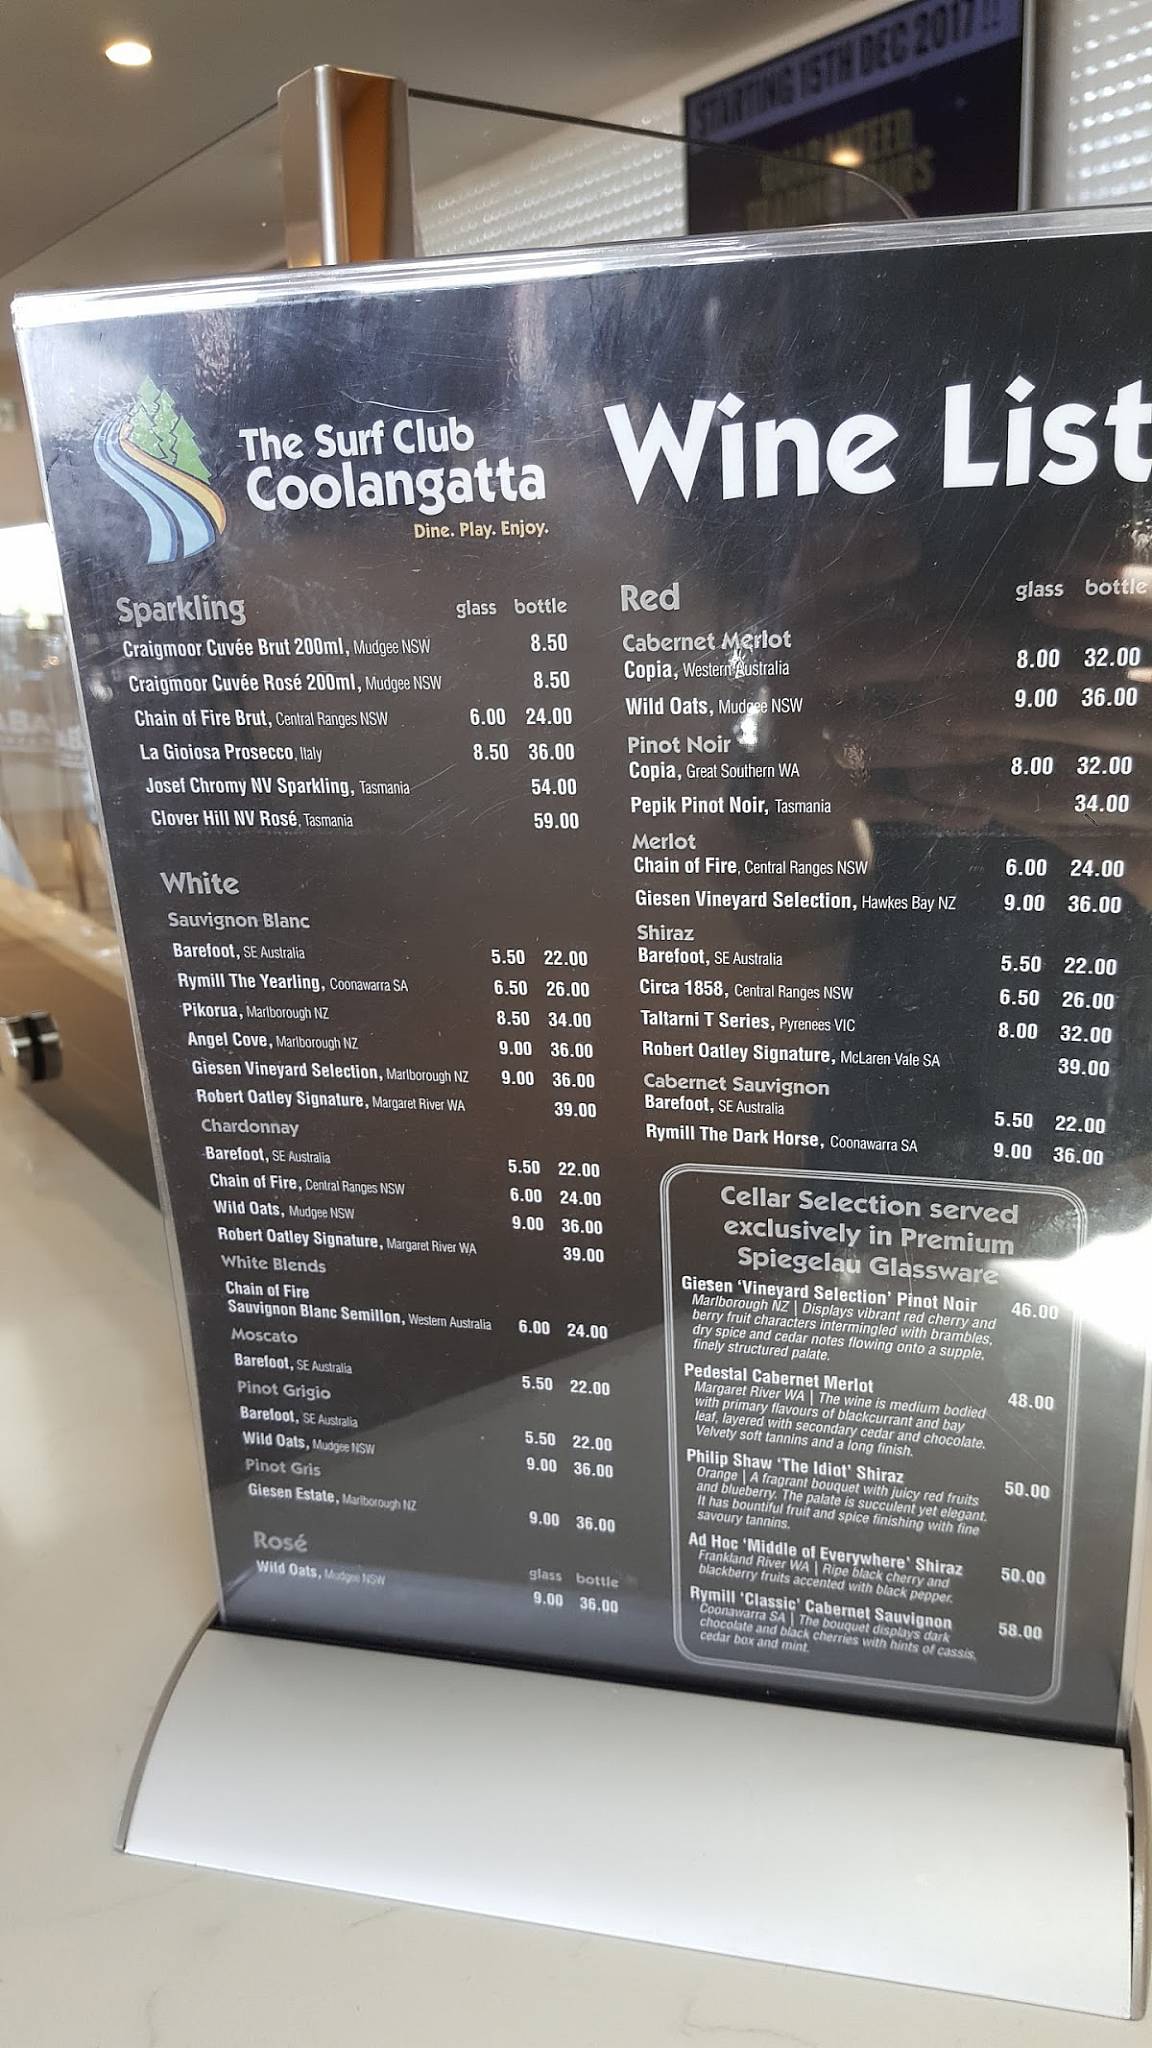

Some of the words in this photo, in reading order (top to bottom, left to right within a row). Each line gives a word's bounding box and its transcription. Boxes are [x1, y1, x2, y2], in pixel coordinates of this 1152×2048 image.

[859, 27, 909, 73] DEC
[913, 0, 974, 57] 2017
[238, 427, 303, 461] The
[315, 419, 384, 458] Surf
[393, 417, 474, 453] Club
[603, 392, 899, 504] Wine
[943, 375, 1152, 487] List
[246, 457, 546, 516] Coolangatta
[413, 523, 454, 539] Dine.
[459, 521, 496, 539] Play.
[500, 520, 549, 537] Enjoy.
[621, 582, 681, 612] Red
[1015, 581, 1064, 601] glass
[1085, 579, 1147, 596] bottle
[116, 595, 246, 628] Sparkling
[455, 600, 497, 618] glass
[513, 598, 568, 615] bottle
[123, 639, 202, 662] Craigmoor
[206, 638, 254, 657] Cuvée
[258, 639, 291, 656] Brut
[294, 637, 350, 657] 200ml,
[353, 639, 399, 657] Mudgee
[402, 638, 431, 654] NSW
[530, 634, 568, 652] 8.50
[622, 632, 716, 652] Cabernet
[721, 630, 791, 651] Merlot
[1016, 648, 1061, 669] 8.00
[1084, 647, 1141, 667] 32.00
[624, 659, 679, 682] Copia,
[682, 661, 732, 678] Western
[735, 660, 790, 677] Australia
[134, 709, 178, 727] Chain
[181, 709, 196, 727] of
[200, 709, 231, 726] Fire
[234, 709, 273, 729] Brut,
[275, 712, 314, 726] Central
[317, 712, 357, 729] Ranges
[359, 711, 388, 726] NSW
[469, 708, 506, 726] 6.00
[525, 707, 573, 725] 24.00
[140, 743, 159, 760] La
[162, 743, 220, 761] Gioiosa
[224, 743, 298, 762] Prosecco,
[300, 746, 323, 764] Italy
[473, 743, 509, 761] 8.50
[528, 743, 575, 761] 36.00
[145, 777, 186, 796] Josef
[189, 776, 246, 798] Chromy
[251, 777, 272, 794] NV
[277, 778, 355, 799] Sparkling,
[359, 780, 410, 795] Tasmania
[530, 777, 577, 796] 54.00
[630, 795, 676, 817] Pepik
[681, 795, 725, 814] Pinot
[729, 795, 769, 816] Noir,
[775, 799, 832, 814] Tasmania
[1073, 793, 1130, 813] 34.00
[631, 834, 696, 850] Merlot
[160, 872, 240, 895] White
[635, 890, 690, 908] Giesen
[695, 891, 767, 911] Vineyard
[772, 892, 857, 912] Selection,
[861, 894, 907, 911] Hawkes
[911, 896, 935, 912] Bay
[938, 895, 956, 911] NZ
[1003, 894, 1045, 912] 9.00
[1067, 895, 1122, 914] 36.00
[167, 912, 259, 930] Sauvignon
[263, 913, 310, 929] Blanc
[636, 925, 695, 942] Shiraz
[173, 943, 240, 961] Barefoot,
[243, 945, 258, 959] SE
[261, 945, 305, 960] Australia
[491, 949, 525, 965] 5.50
[543, 950, 588, 967] 22.00
[178, 973, 226, 992] Rymill
[229, 973, 256, 989] The
[259, 974, 326, 994] Yearling,
[330, 978, 391, 992] Coonawarra
[393, 979, 409, 992] SA
[494, 980, 528, 996] 6.50
[546, 981, 590, 998] 26.00
[639, 978, 680, 996] Circa
[684, 979, 729, 999] 1858,
[734, 983, 775, 998] Central
[778, 984, 820, 1001] Ranges
[823, 985, 853, 1000] NSW
[999, 989, 1040, 1007] 6.50
[1061, 991, 1115, 1010] 26.00
[640, 1009, 699, 1028] Taltarni
[703, 1011, 715, 1028] T
[718, 1012, 775, 1031] Series,
[779, 1016, 832, 1033] Pyrenees
[834, 1017, 855, 1032] VIC
[998, 1022, 1038, 1040] 8.00
[1059, 1024, 1113, 1044] 32.00
[643, 1073, 727, 1091] Cabernet
[732, 1076, 830, 1096] Sauvignon
[201, 1119, 299, 1138] Chardonnay
[213, 1199, 245, 1215] Wild
[249, 1201, 285, 1218] Oats,
[289, 1205, 328, 1219] Mudgee
[330, 1206, 355, 1219] NSW
[720, 1186, 790, 1209] Cellar
[798, 1191, 921, 1216] Selection
[930, 1201, 1019, 1225] served
[511, 1216, 544, 1231] 9.00
[561, 1218, 603, 1235] 36.00
[723, 1218, 861, 1247] exclusively
[869, 1222, 892, 1245] in
[901, 1229, 1015, 1255] Premium
[220, 1254, 268, 1270] White
[273, 1257, 326, 1273] Blends
[737, 1247, 861, 1275] Spiegelau
[869, 1257, 999, 1285] Glassware
[682, 1275, 733, 1293] Giesen
[896, 1292, 940, 1309] Pinot
[943, 1296, 978, 1312] Noir
[1011, 1302, 1059, 1320] 46.00
[231, 1327, 298, 1344] Moscato
[692, 1308, 724, 1325] berry
[727, 1311, 751, 1327] fruit
[754, 1314, 818, 1330] characters
[820, 1318, 898, 1338] intermingled
[900, 1324, 928, 1339] with
[930, 1327, 993, 1346] brambles.
[684, 1362, 748, 1383] Pedestal
[752, 1368, 819, 1388] Cabernet
[824, 1374, 874, 1393] Merlot
[237, 1380, 279, 1395] Pinot
[283, 1384, 332, 1400] Grigio
[1007, 1392, 1055, 1411] 48.00
[687, 1449, 729, 1468] Philip
[732, 1452, 773, 1470] Shaw
[856, 1464, 904, 1484] Shiraz
[1004, 1481, 1050, 1499] 50.00
[253, 1531, 309, 1552] Rosé
[690, 1585, 737, 1605] Rymill
[805, 1599, 871, 1619] Cabernet
[875, 1606, 952, 1631] Sauvignon
[998, 1623, 1042, 1640] 58.00
